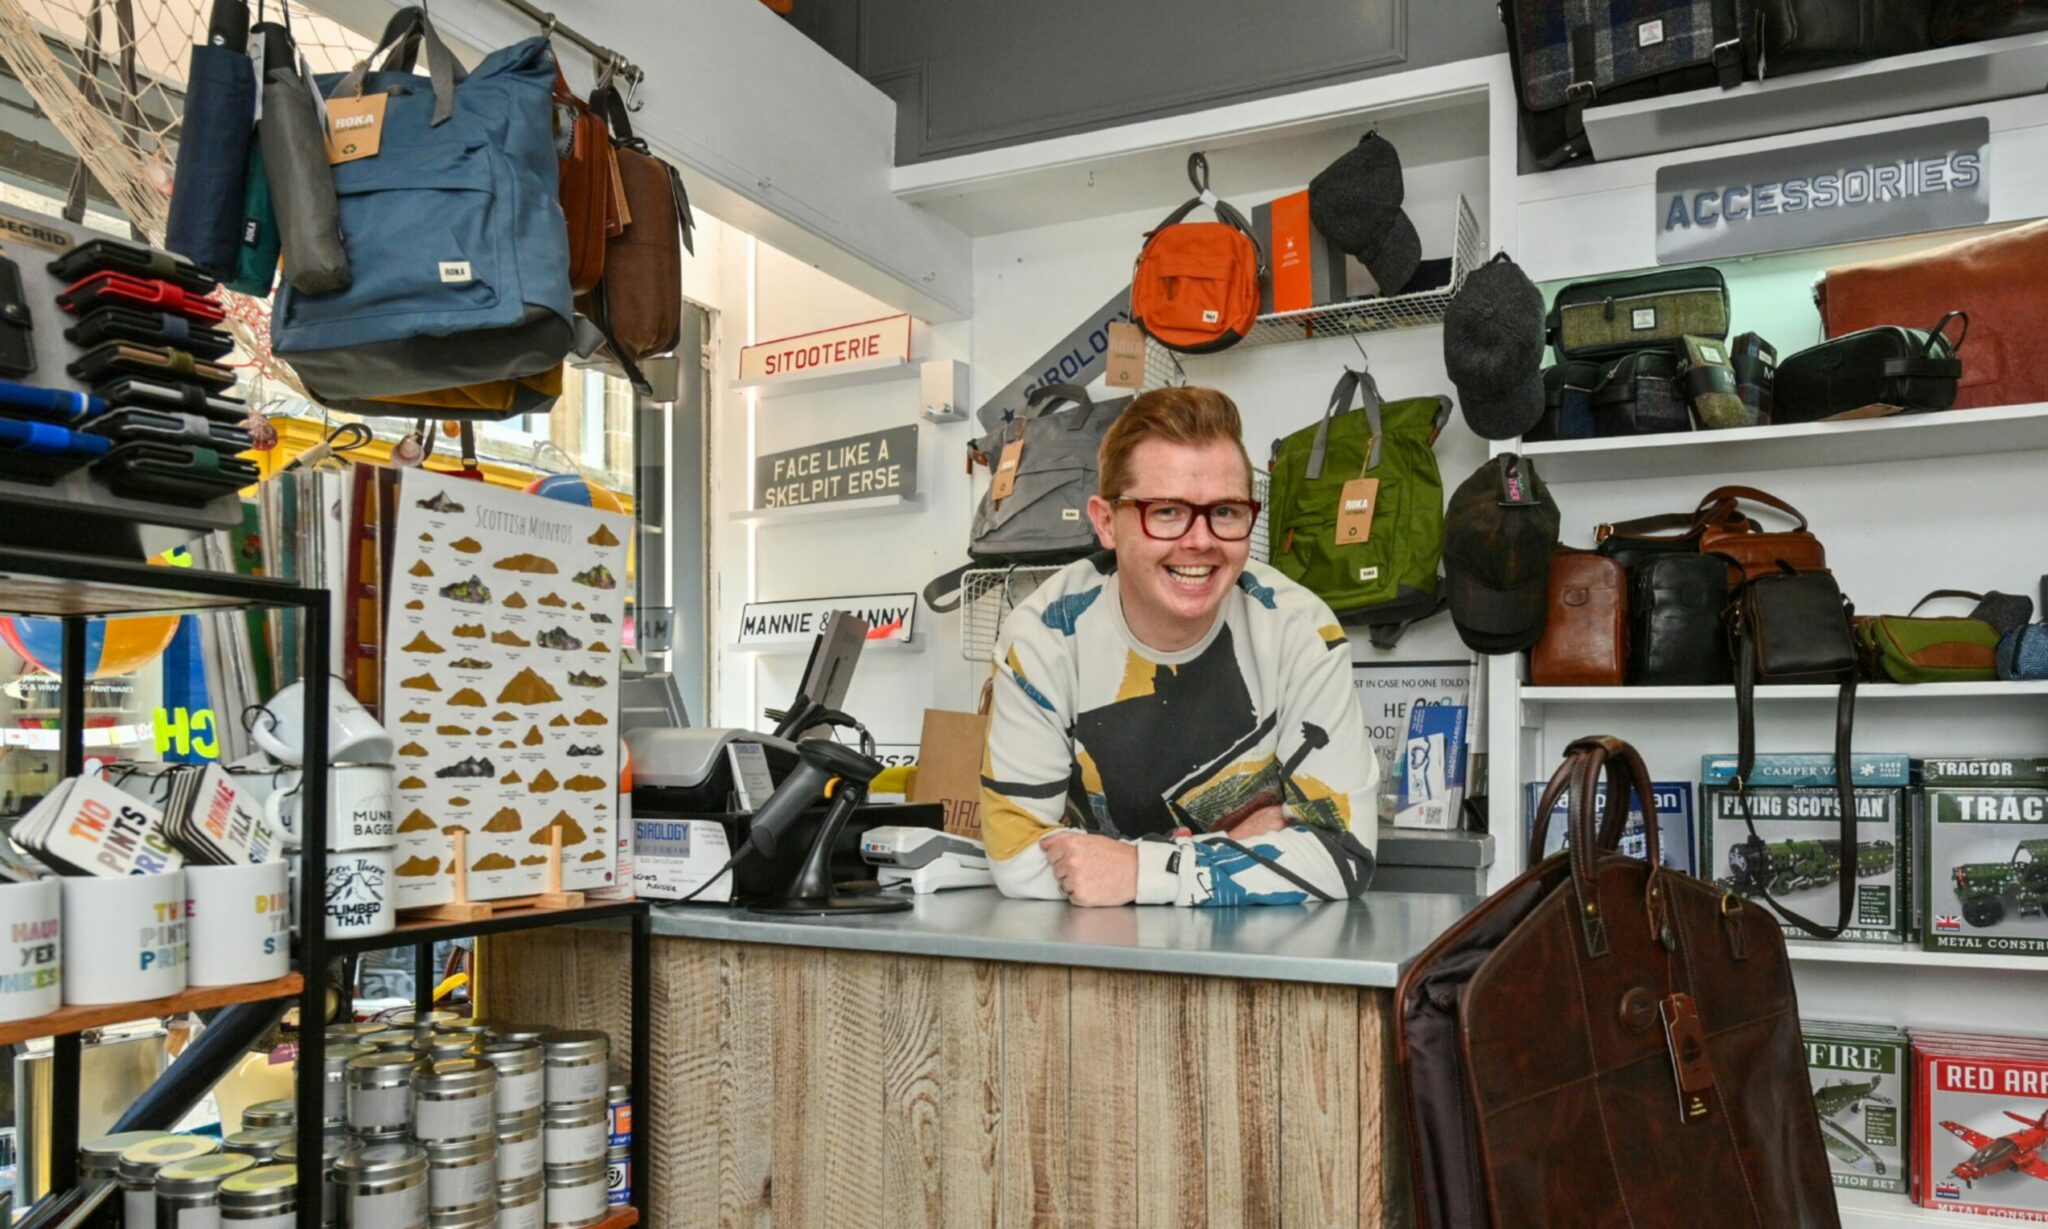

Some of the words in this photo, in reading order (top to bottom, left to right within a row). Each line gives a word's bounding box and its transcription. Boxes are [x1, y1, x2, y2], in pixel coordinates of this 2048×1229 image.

[335, 114, 375, 129] ROKA
[1666, 153, 1980, 232] ACCESSORIES
[765, 333, 881, 375] SITOOTERIE
[774, 452, 821, 481] FACE
[827, 441, 871, 472] LIKE
[877, 438, 889, 462] A
[765, 476, 842, 509] SKELPIT
[847, 464, 901, 495] ERSE
[743, 613, 813, 636] MANNIE
[842, 607, 910, 630] ANNY
[1353, 680, 1364, 689] ST
[1366, 680, 1376, 688] IN
[1377, 680, 1400, 688] CASE
[1401, 679, 1416, 688] NO
[1419, 679, 1438, 688] ONE
[1440, 678, 1464, 688] TOLD
[1762, 766, 1817, 776] CAMPER
[1824, 765, 1837, 776] VA
[1937, 761, 2013, 776] TRACTOR
[353, 810, 394, 822] MUNR
[1787, 796, 1884, 818] SCOTSAN
[1957, 795, 2048, 821] TRAC
[68, 798, 112, 843] TWO
[353, 823, 394, 836] BAGGE
[96, 805, 147, 874] PINTS
[636, 822, 689, 841] SIROLOGY
[326, 902, 381, 917] CLIMBED
[336, 913, 373, 927] THAT
[1865, 929, 1889, 940] SET
[1937, 936, 1982, 948] METAL
[1987, 939, 2048, 951] CONSTR
[1947, 1065, 1994, 1090] RED
[1873, 1177, 1896, 1190] SET
[1937, 1203, 1979, 1215] METAL
[1986, 1208, 2048, 1222] CONSTR
